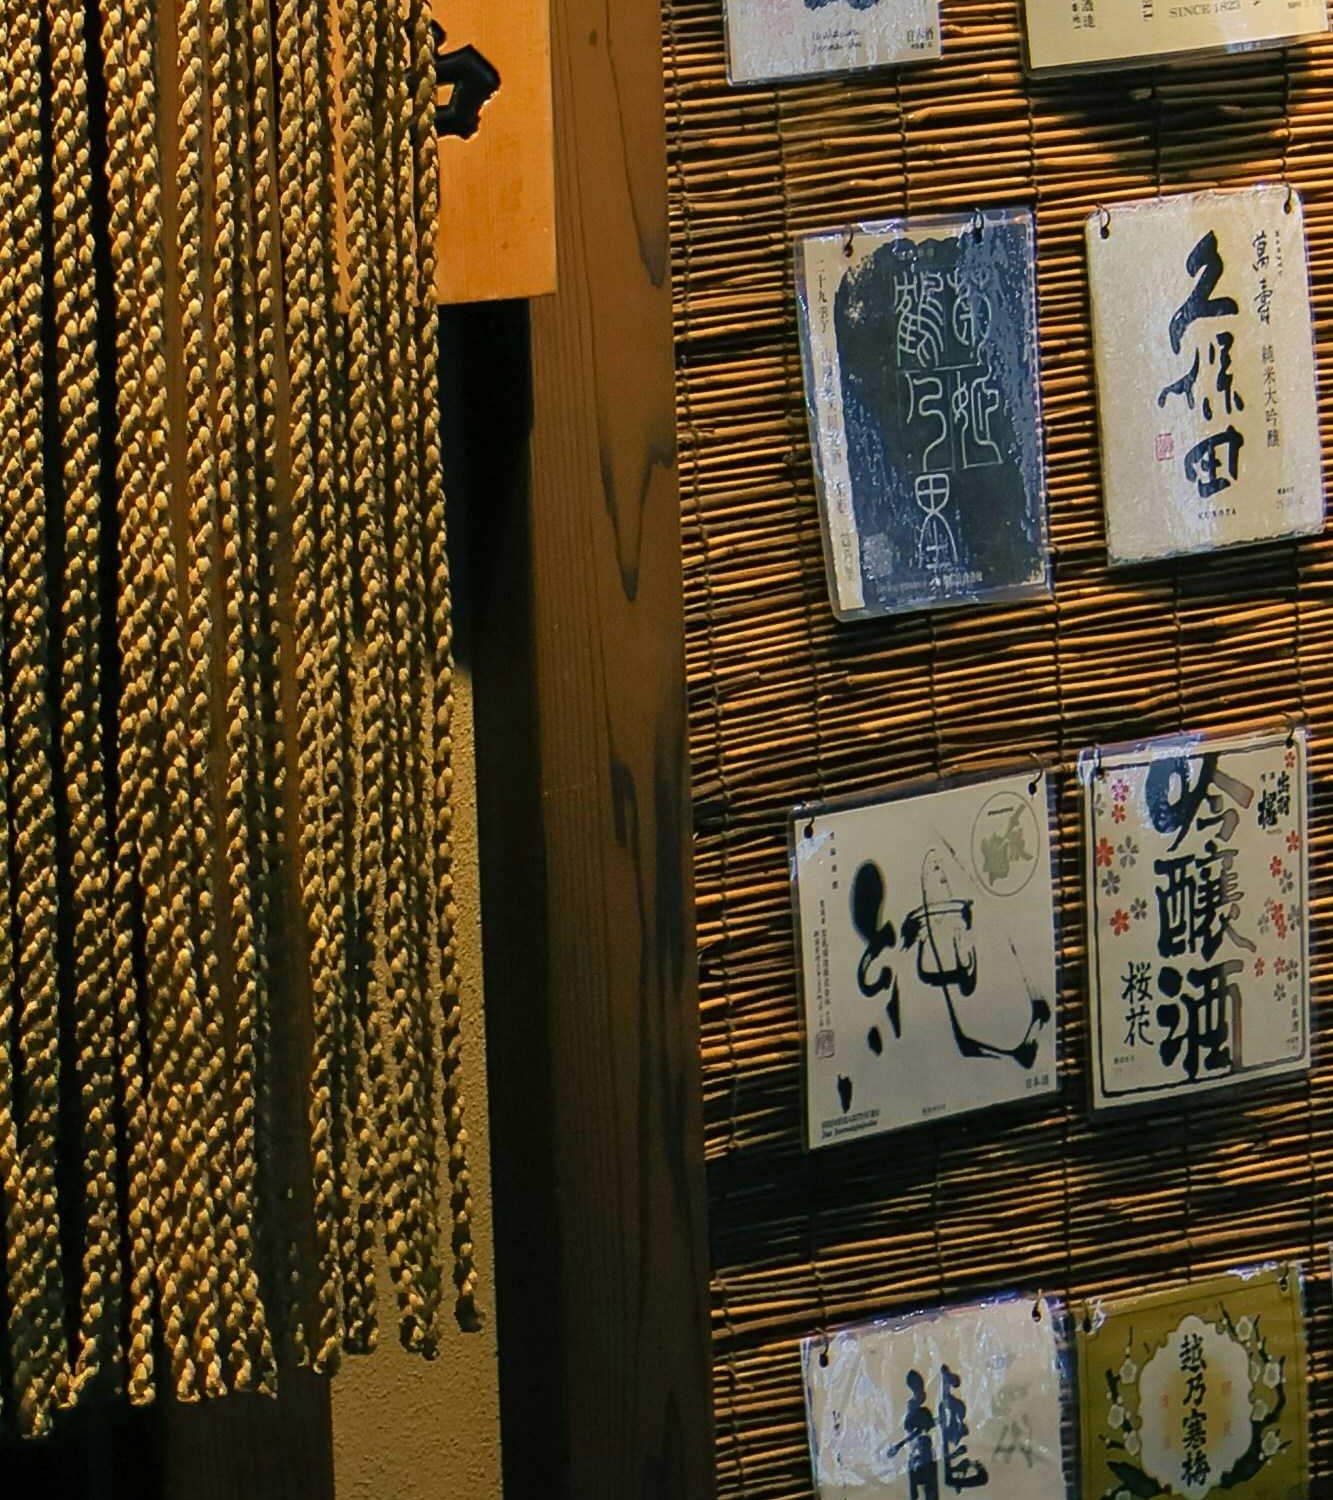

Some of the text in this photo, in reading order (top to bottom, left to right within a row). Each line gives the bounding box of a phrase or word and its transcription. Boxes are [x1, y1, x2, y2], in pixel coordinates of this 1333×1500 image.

[1169, 3, 1212, 18] SINCE
[1158, 230, 1244, 499] 久保田
[1260, 344, 1280, 448] 純米大吟醸
[1144, 752, 1257, 1081] 吟醸酒
[1120, 961, 1154, 1047] 桜花
[1179, 1333, 1211, 1487] 越乃寒梅
